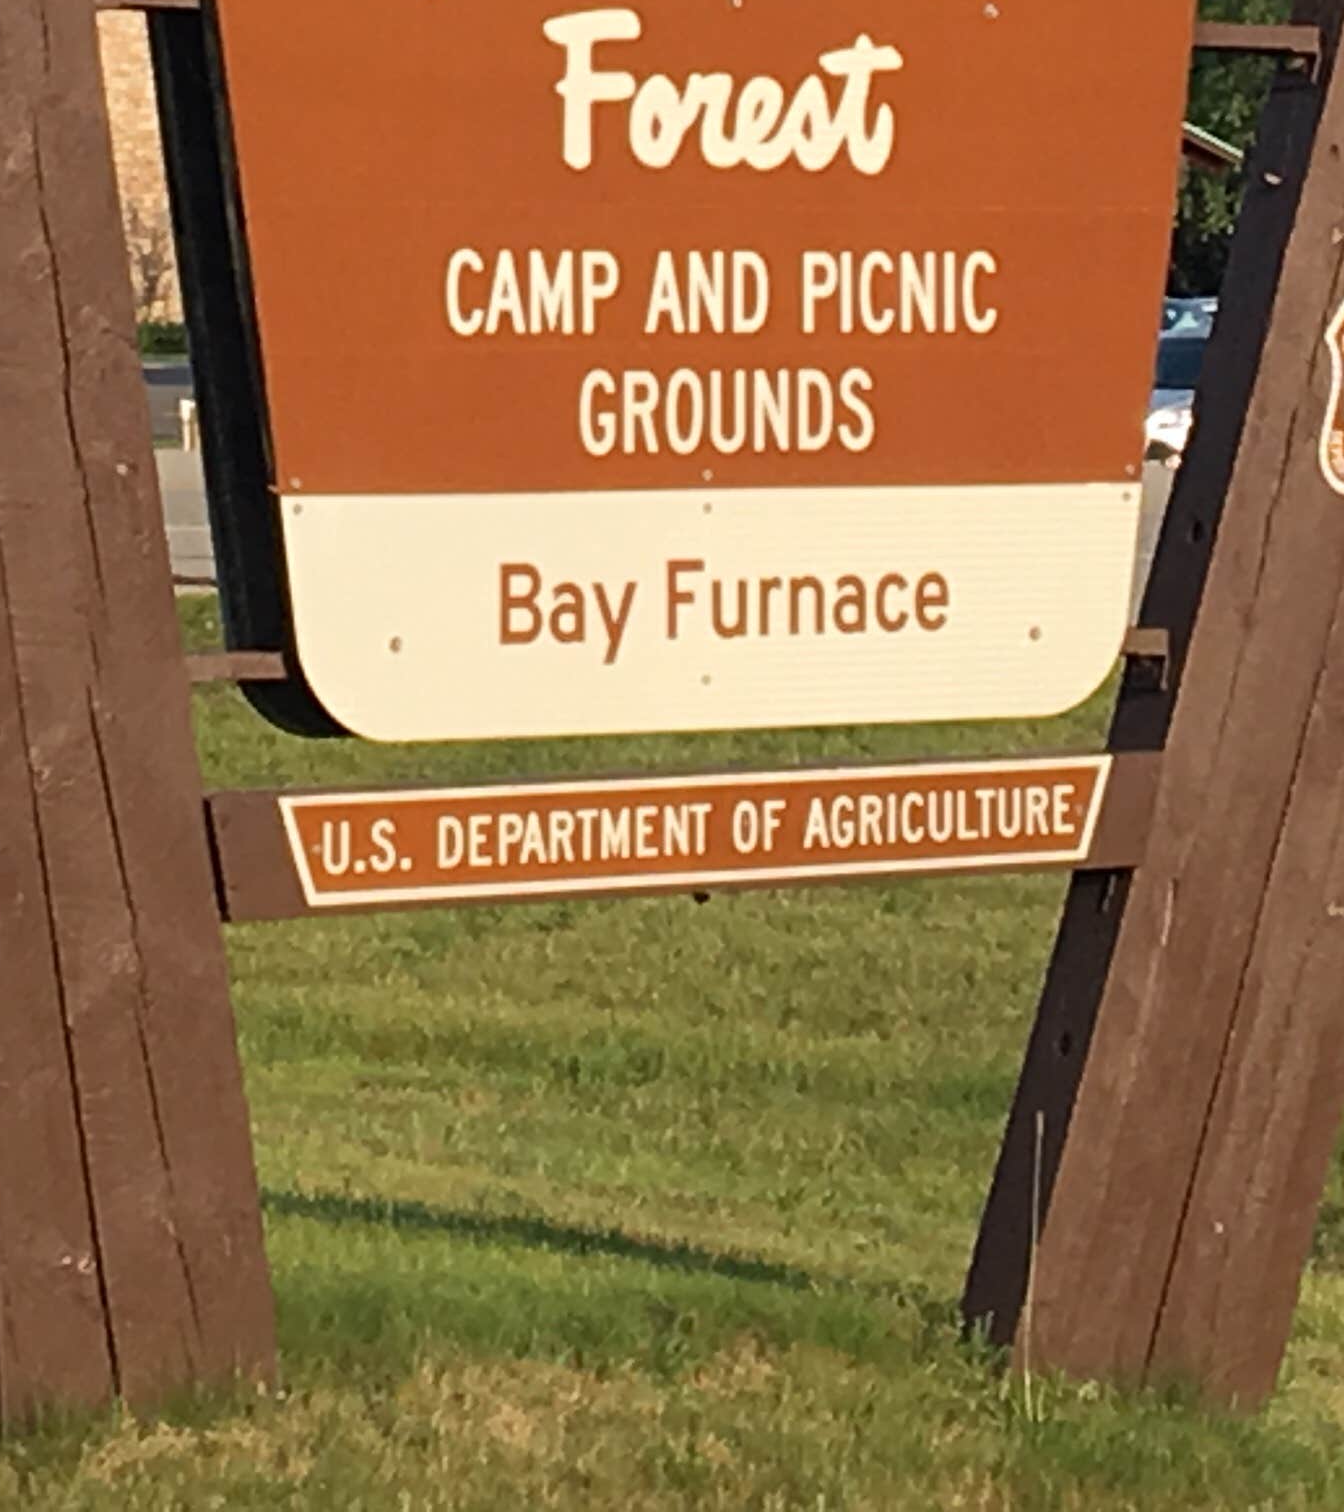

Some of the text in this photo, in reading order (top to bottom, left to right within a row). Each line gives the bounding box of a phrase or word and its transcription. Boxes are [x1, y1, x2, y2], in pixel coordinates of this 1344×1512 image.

[542, 7, 904, 176] Forest
[445, 247, 998, 336] CAMP AND PICNIC
[578, 366, 875, 457] GROUNDS
[498, 558, 950, 666] Bay Furnace
[322, 783, 1076, 876] U.S. DEPARTMENT OF AGRICULTURE
